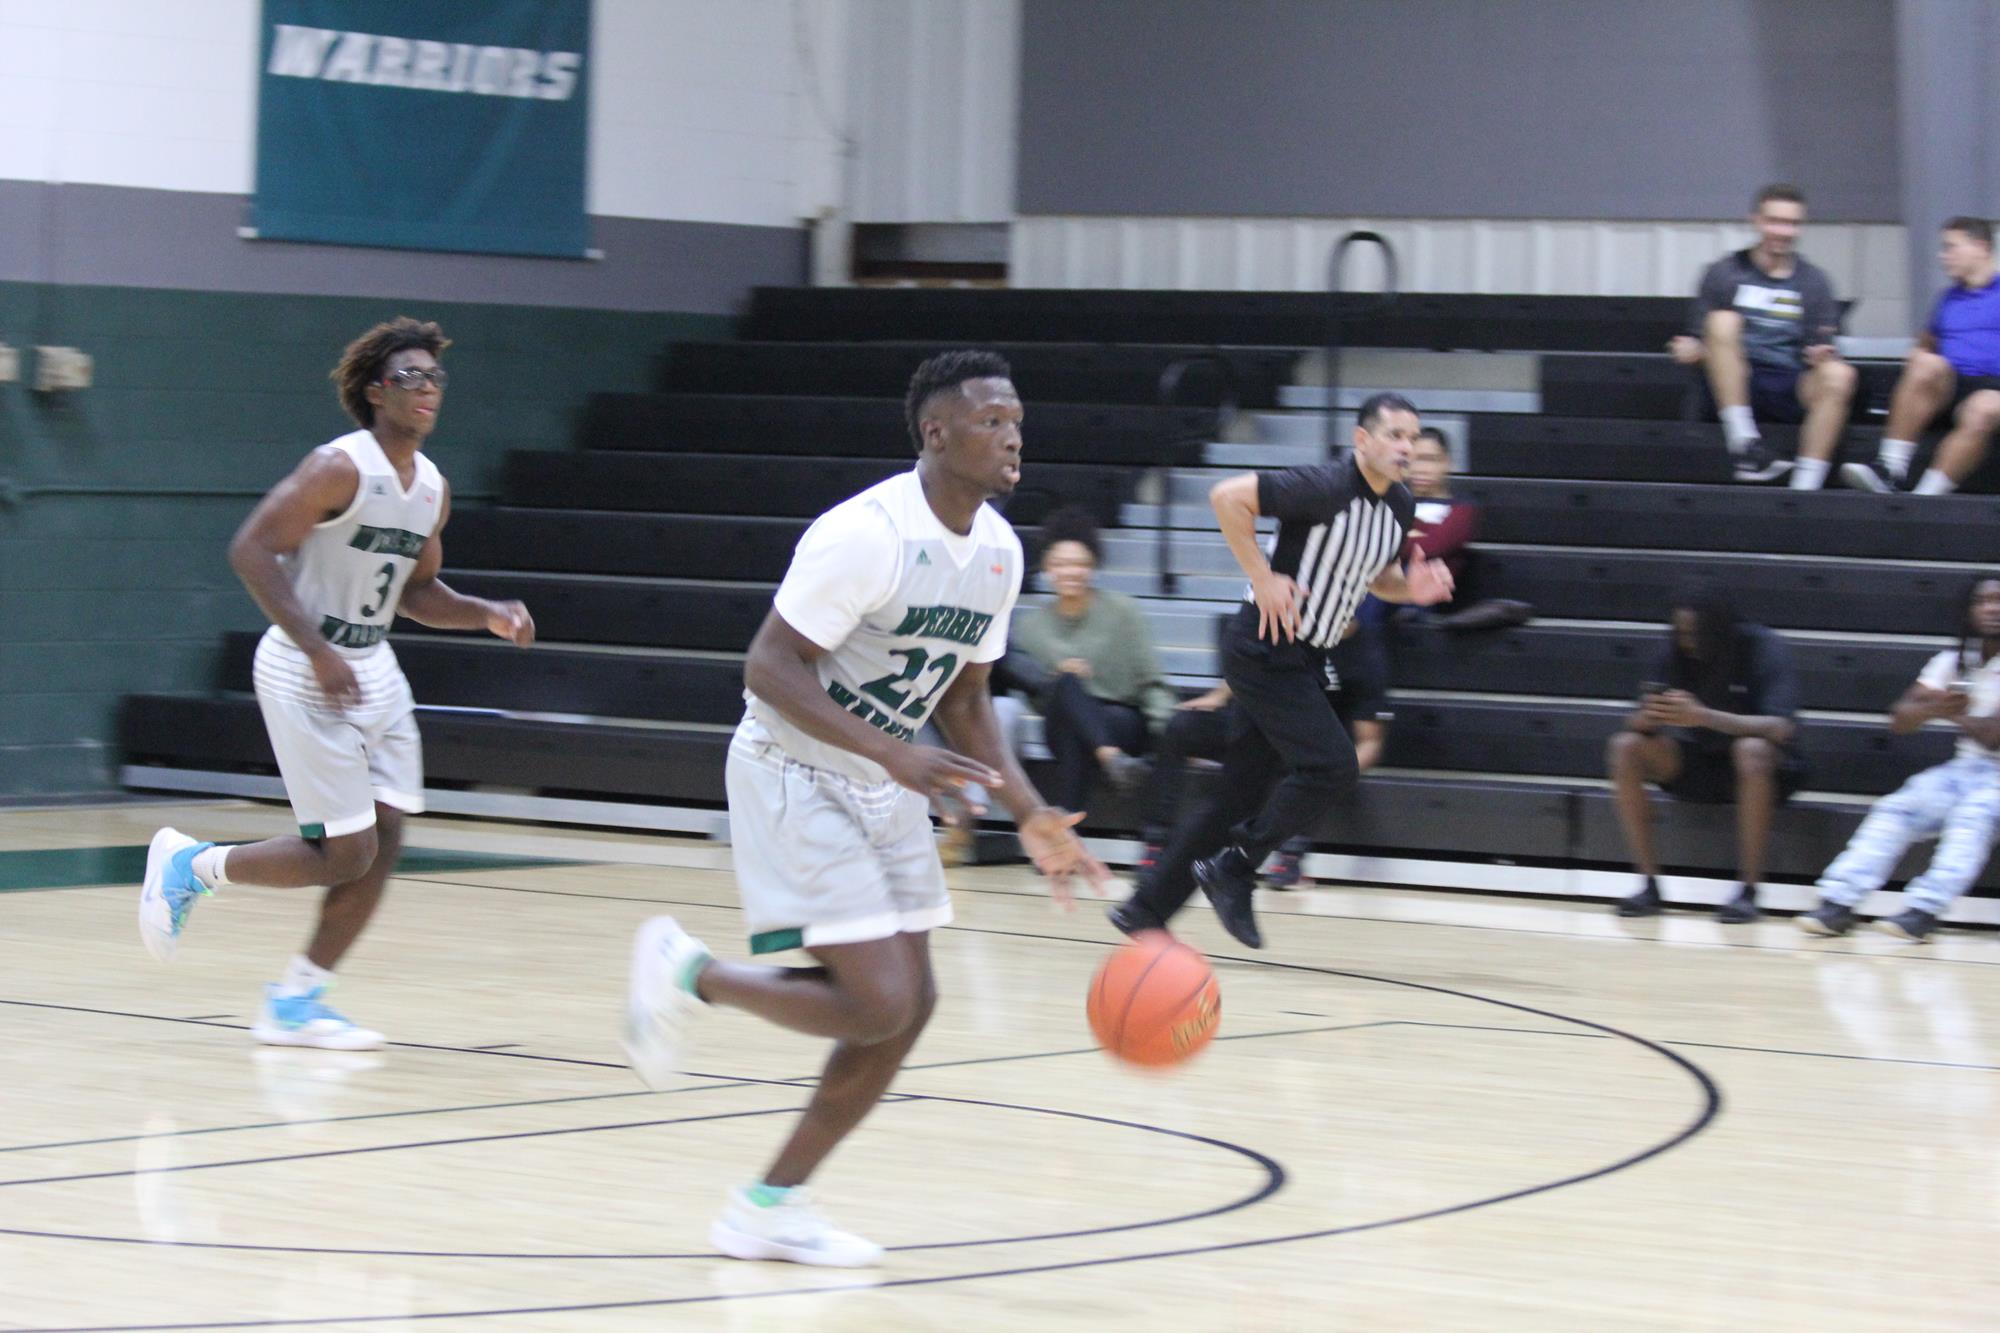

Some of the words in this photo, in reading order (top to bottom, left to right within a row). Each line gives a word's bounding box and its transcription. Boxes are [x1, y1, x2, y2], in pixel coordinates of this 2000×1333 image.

[267, 24, 582, 101] WARRIORS
[360, 562, 397, 618] 3
[859, 647, 958, 719] 22
